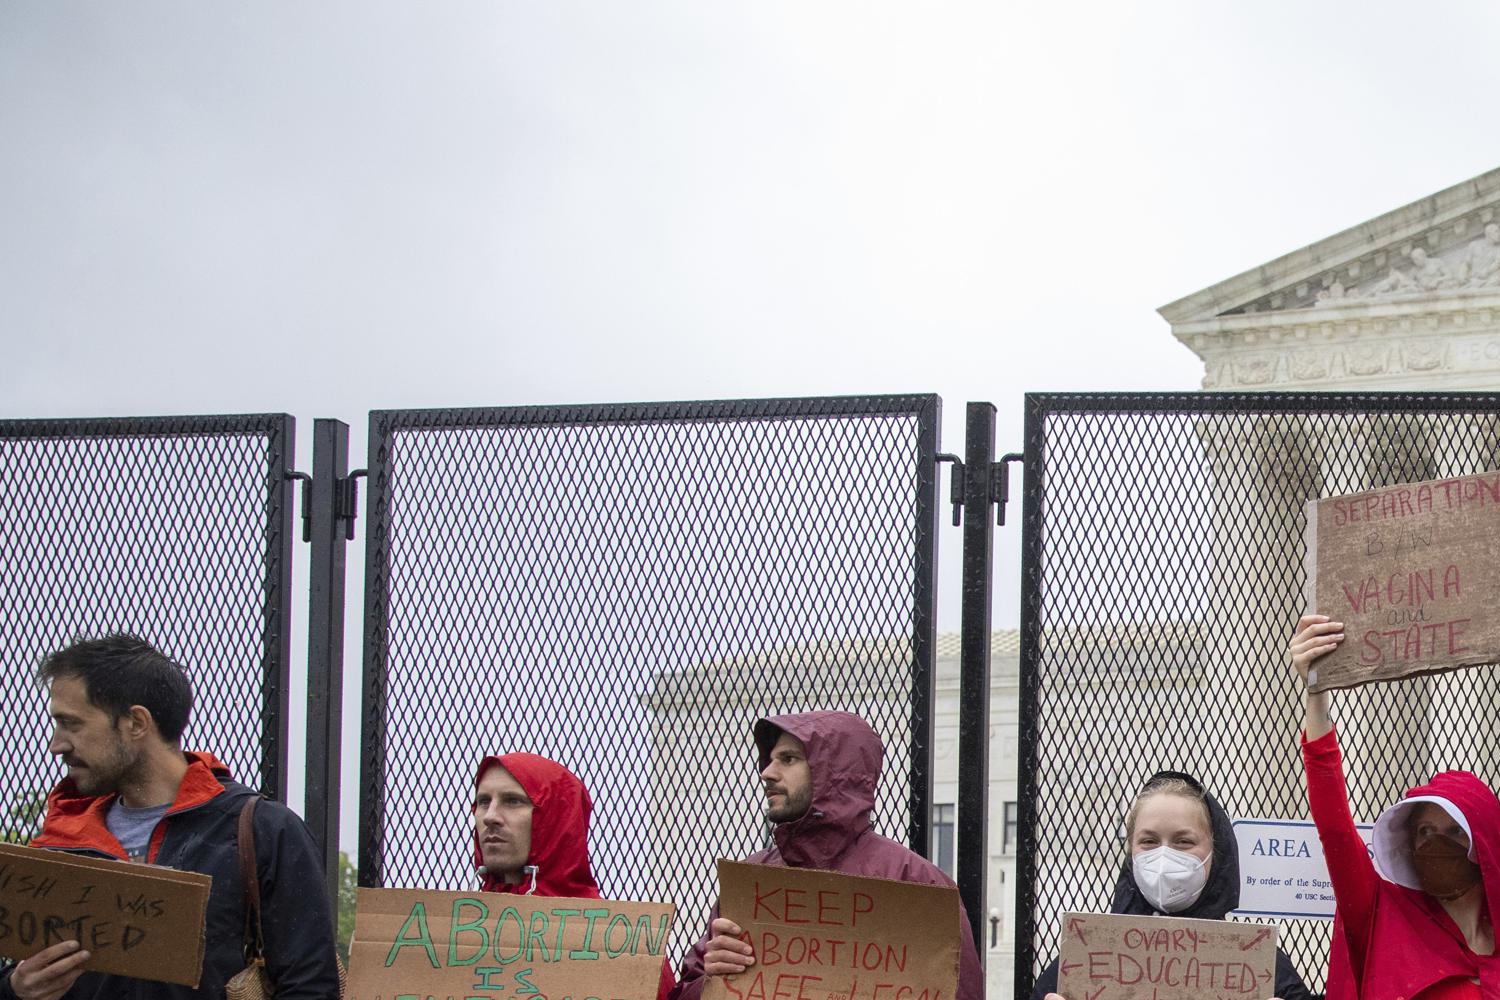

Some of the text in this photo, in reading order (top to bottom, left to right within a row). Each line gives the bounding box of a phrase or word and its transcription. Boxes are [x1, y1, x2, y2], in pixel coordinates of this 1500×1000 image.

[1334, 475, 1500, 526] SEPARATION
[1342, 564, 1461, 614] VAGINA
[1387, 604, 1432, 626] and
[1361, 618, 1471, 663] STATE
[1251, 838, 1312, 858] AREA
[0, 864, 166, 917] ISH I WAS
[1246, 876, 1257, 886] By
[1260, 877, 1281, 886] order
[1284, 878, 1294, 887] of
[1297, 878, 1309, 887] the
[753, 882, 874, 927] KEEP
[384, 897, 669, 969] ABORTION
[737, 930, 907, 973] ABORTION
[1123, 928, 1208, 953] OVARY-
[473, 966, 540, 994] IS
[1088, 951, 1257, 994] EDUCATED
[826, 992, 847, 1000] AND
